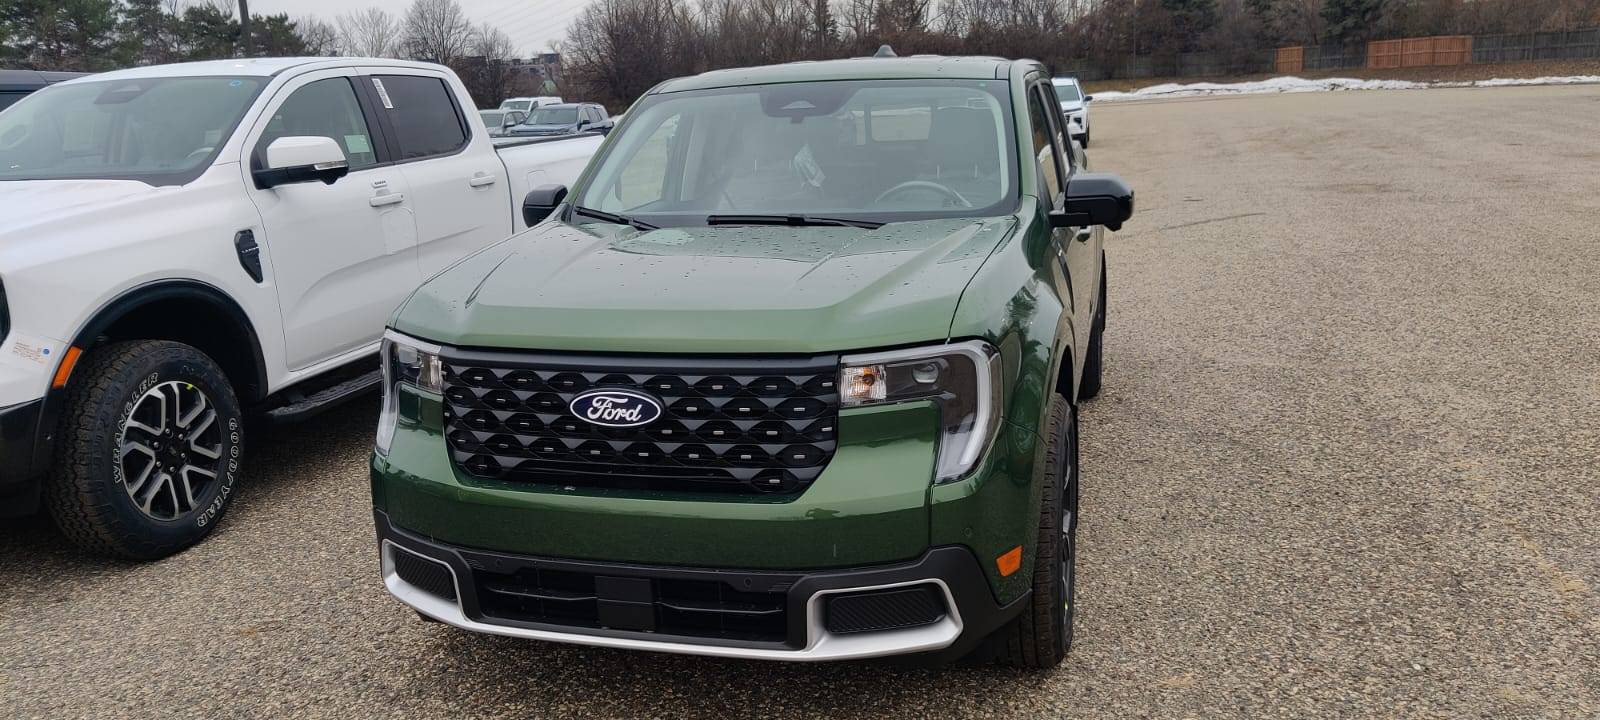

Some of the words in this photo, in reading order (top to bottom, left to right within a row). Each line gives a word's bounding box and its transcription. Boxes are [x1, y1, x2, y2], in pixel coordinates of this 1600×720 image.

[113, 372, 158, 483] WRANGLER
[587, 396, 642, 421] Ford
[197, 418, 239, 526] GOODYEAR
